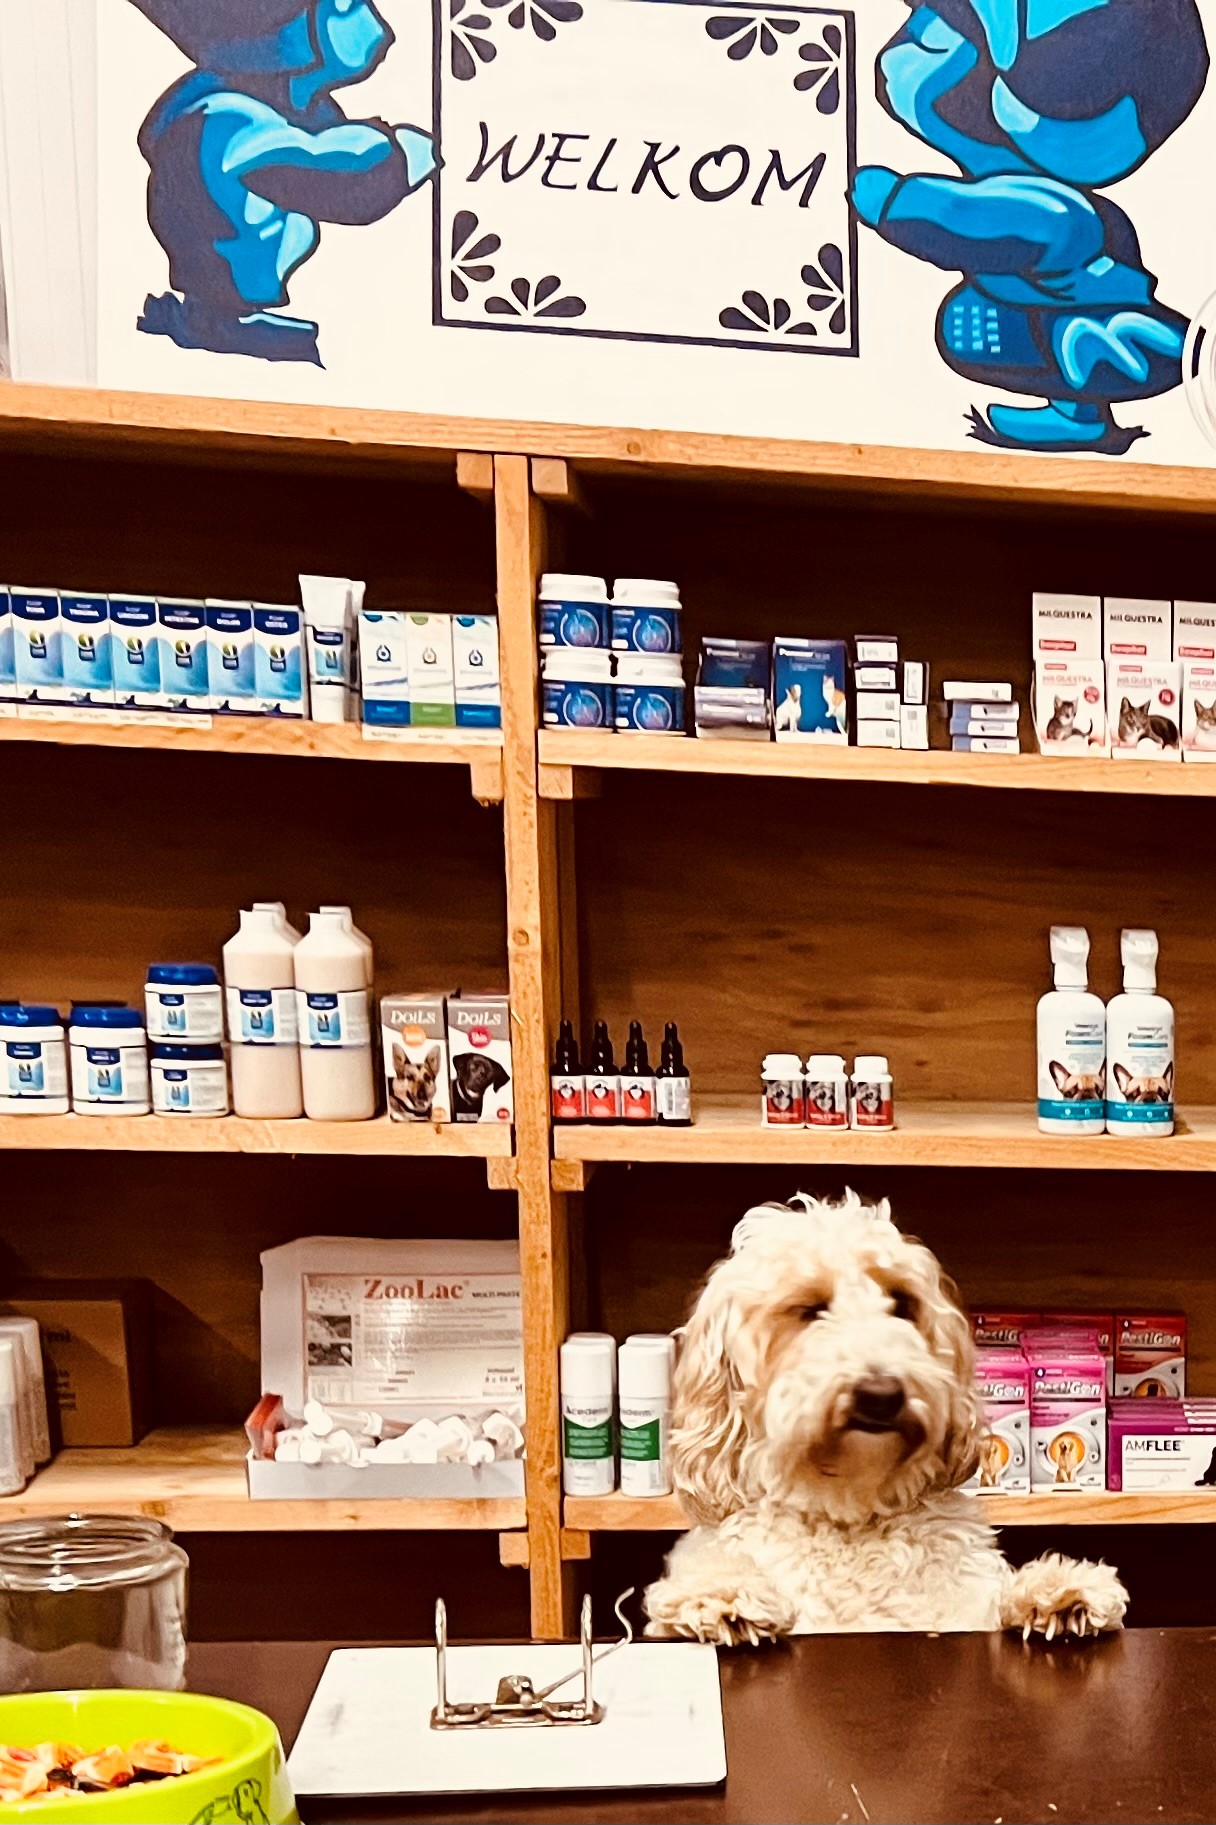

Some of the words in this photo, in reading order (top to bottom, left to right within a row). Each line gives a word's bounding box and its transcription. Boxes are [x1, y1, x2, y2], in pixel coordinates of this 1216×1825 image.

[466, 121, 827, 208] WELKOM
[364, 1280, 463, 1300] ZooLac
[975, 1329, 1018, 1342] PestiG
[1121, 1331, 1181, 1345] PestiGon
[1034, 1380, 1100, 1395] PestiGon
[1125, 1440, 1182, 1451] AMFLEE
